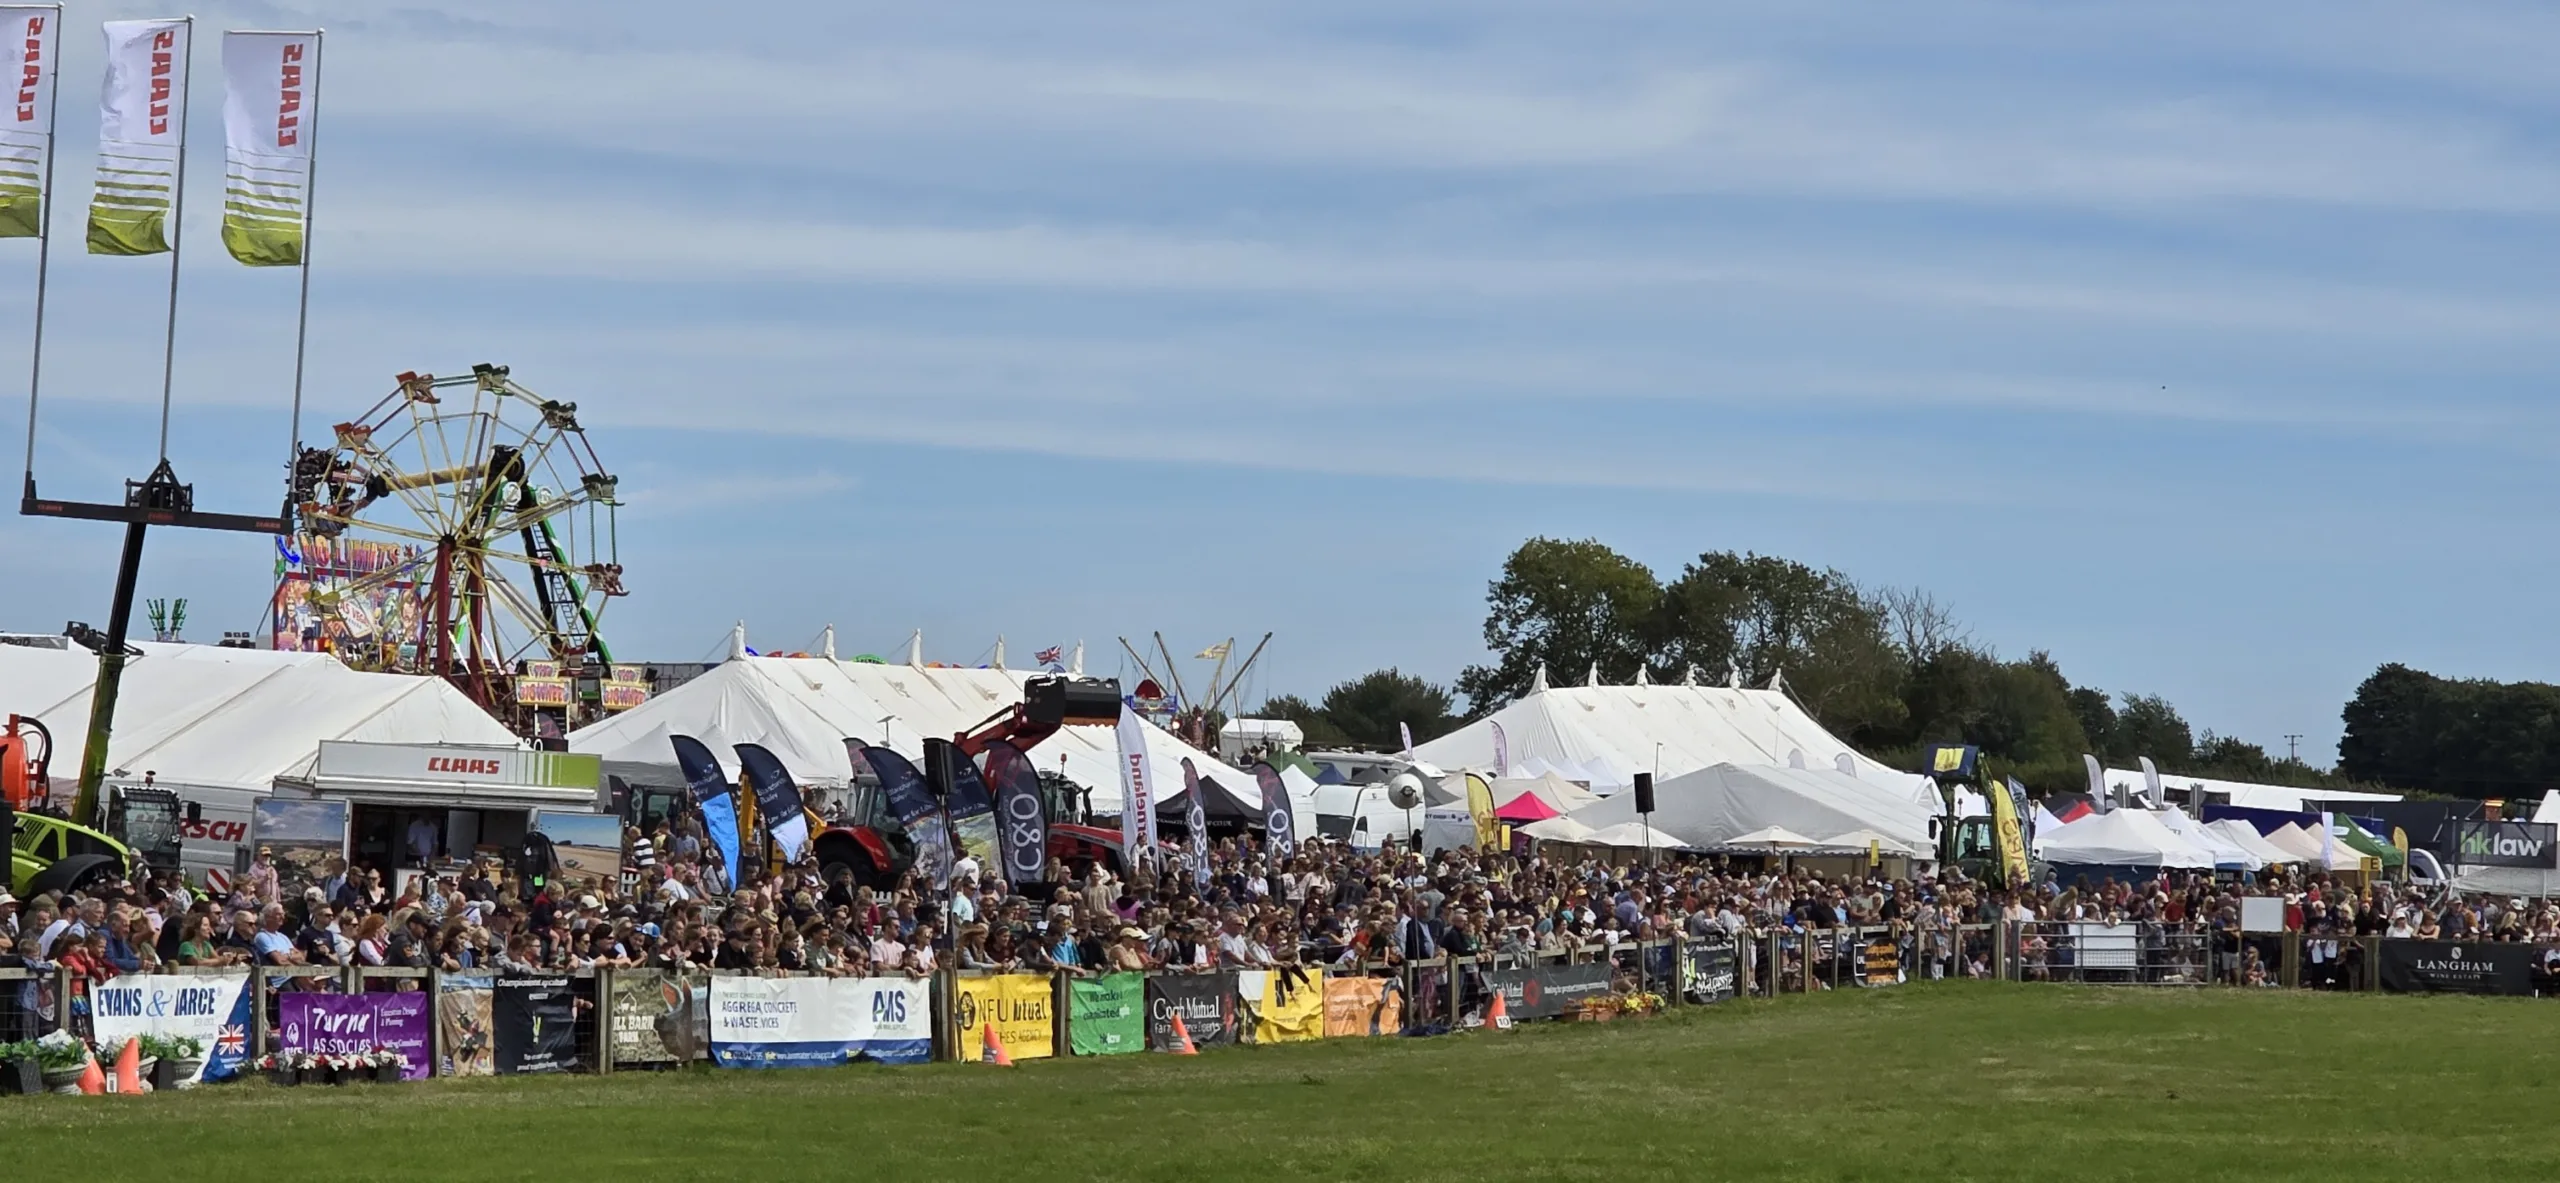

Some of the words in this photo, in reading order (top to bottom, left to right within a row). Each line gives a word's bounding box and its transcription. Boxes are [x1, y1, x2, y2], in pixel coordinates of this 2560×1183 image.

[335, 539, 401, 571] LIMITS
[428, 757, 500, 775] CLAAS
[2417, 959, 2494, 971] LANGHAM
[98, 988, 142, 1017] EVANS
[146, 989, 172, 1017] &
[764, 1001, 798, 1013] CONCRETE
[872, 990, 906, 1023] AMS
[978, 998, 1008, 1023] NFU
[1498, 1017, 1509, 1027] 10
